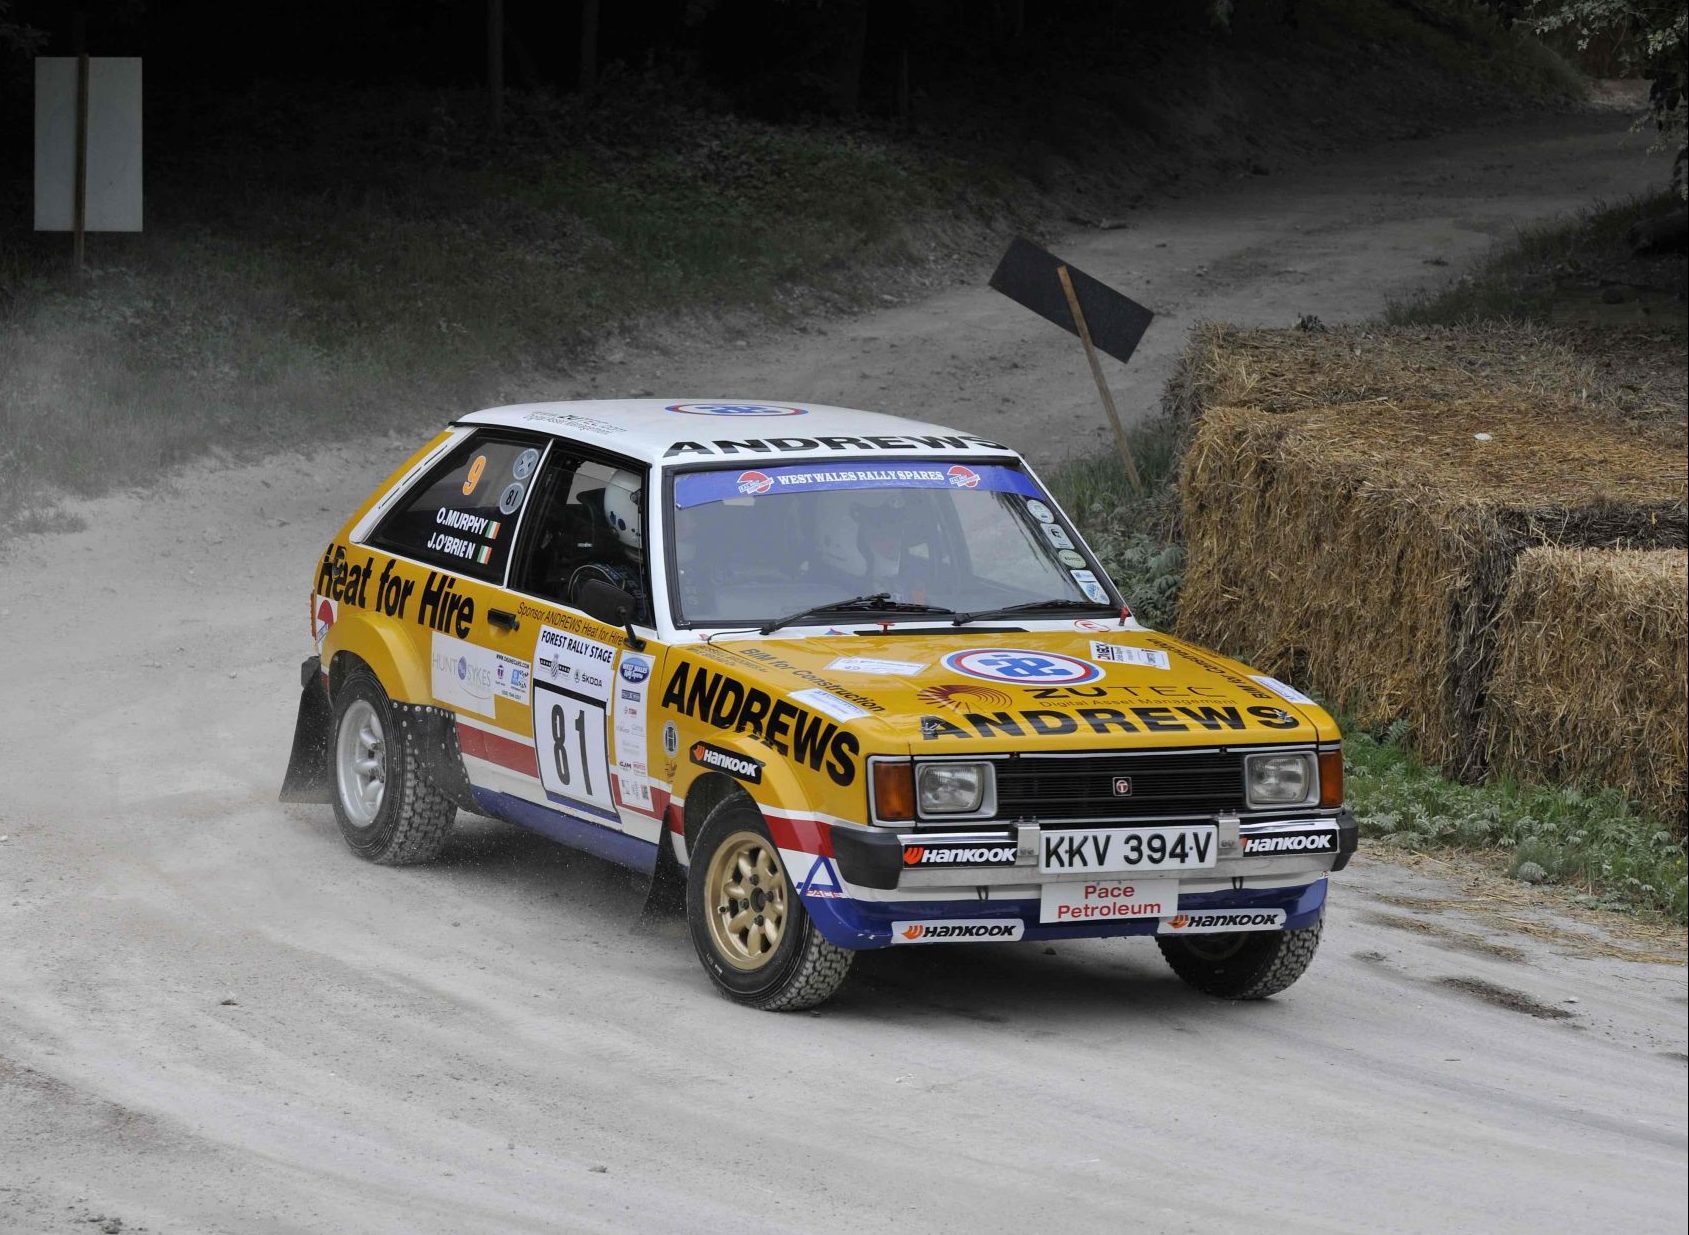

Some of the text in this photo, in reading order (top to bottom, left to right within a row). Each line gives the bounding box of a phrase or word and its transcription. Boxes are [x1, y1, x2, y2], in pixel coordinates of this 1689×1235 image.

[663, 436, 1008, 458] ANDREWS
[463, 455, 486, 495] 9
[778, 473, 812, 485] WEST
[813, 471, 857, 483] WALES
[857, 471, 897, 481] RALLY
[897, 470, 944, 481] SPARES
[506, 489, 518, 507] 81
[436, 507, 489, 535] O.MURPHY
[427, 532, 476, 559] J.O'BRIEN
[317, 543, 475, 639] Heat for Hire
[518, 601, 624, 646] Sponsor ANDREWS Heat for Hire
[541, 630, 613, 664] FOREST RALLY STAGE
[740, 648, 774, 664] BIM
[773, 658, 797, 671] for
[792, 669, 886, 713] Construction
[1024, 686, 1227, 699] ZUTEC
[1040, 698, 1239, 709] Digital Asset Management
[661, 661, 860, 787] ANDREWS
[920, 704, 1300, 741] ANDREWS
[551, 703, 593, 796] 81
[1045, 831, 1212, 868] KKV 394V
[1084, 885, 1135, 900] Pace
[1057, 901, 1161, 919] Petroleum
